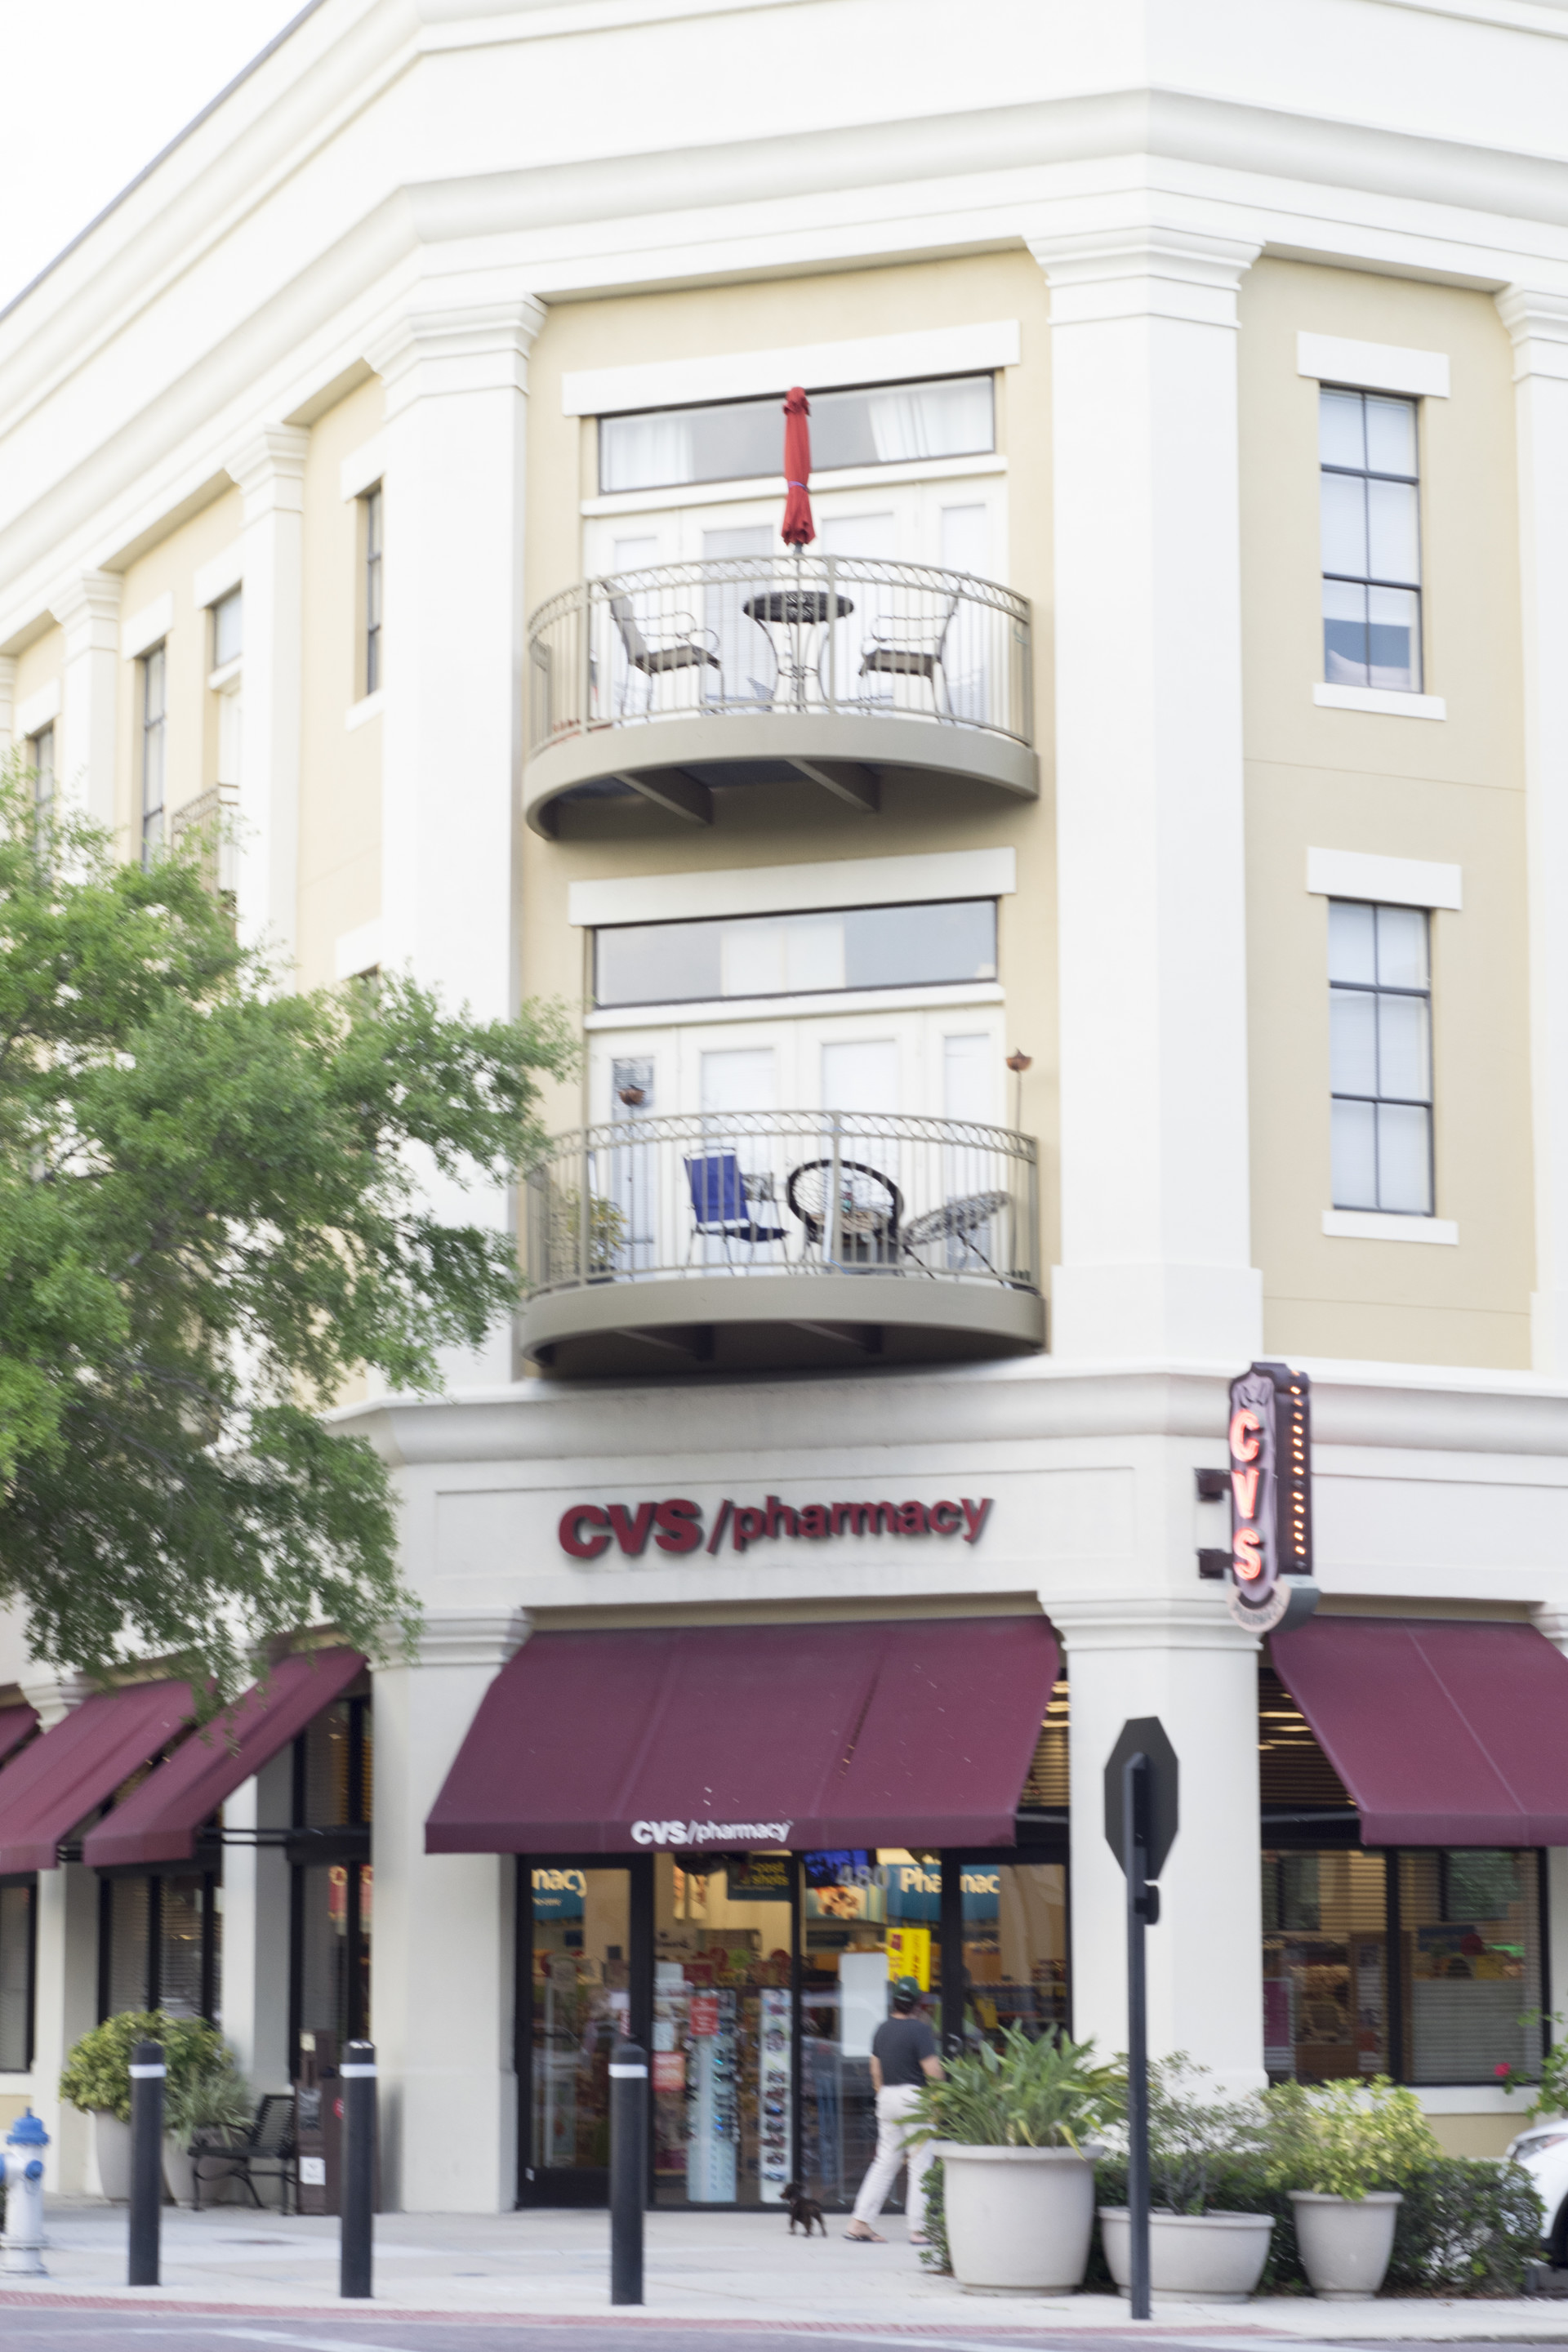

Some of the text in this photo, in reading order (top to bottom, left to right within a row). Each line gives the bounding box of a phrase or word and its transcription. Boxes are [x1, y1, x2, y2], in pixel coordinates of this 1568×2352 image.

[1230, 1408, 1262, 1580] CVS
[558, 1495, 992, 1559] CVS/pharmacy
[630, 1820, 790, 1846] CVS/pharmacy
[836, 1864, 889, 1890] 480
